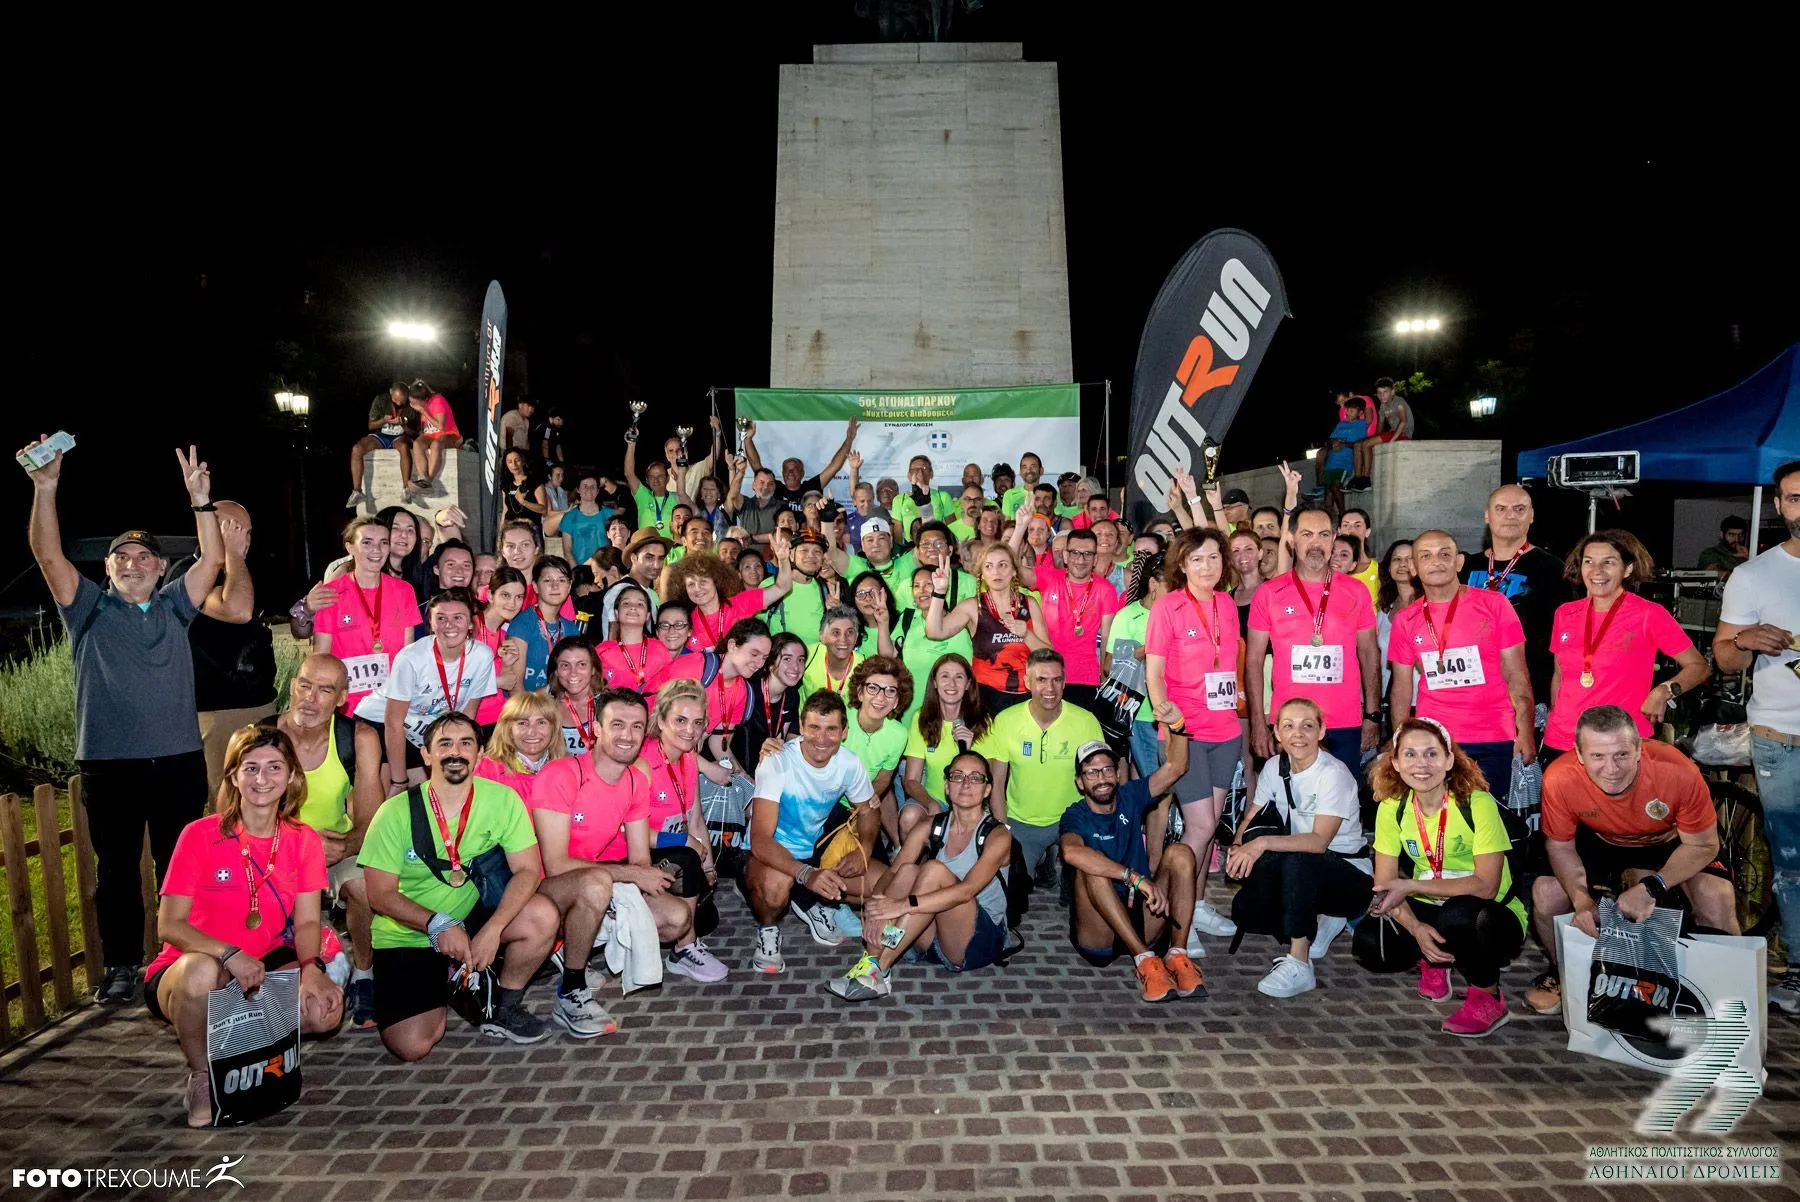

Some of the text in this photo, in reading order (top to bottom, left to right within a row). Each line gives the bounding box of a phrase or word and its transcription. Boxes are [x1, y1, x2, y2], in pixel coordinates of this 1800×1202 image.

[1134, 258, 1271, 514] OUTRUN
[352, 662, 379, 679] 119
[1303, 655, 1331, 670] 478
[213, 1018, 232, 1030] Don't
[232, 1014, 248, 1025] just
